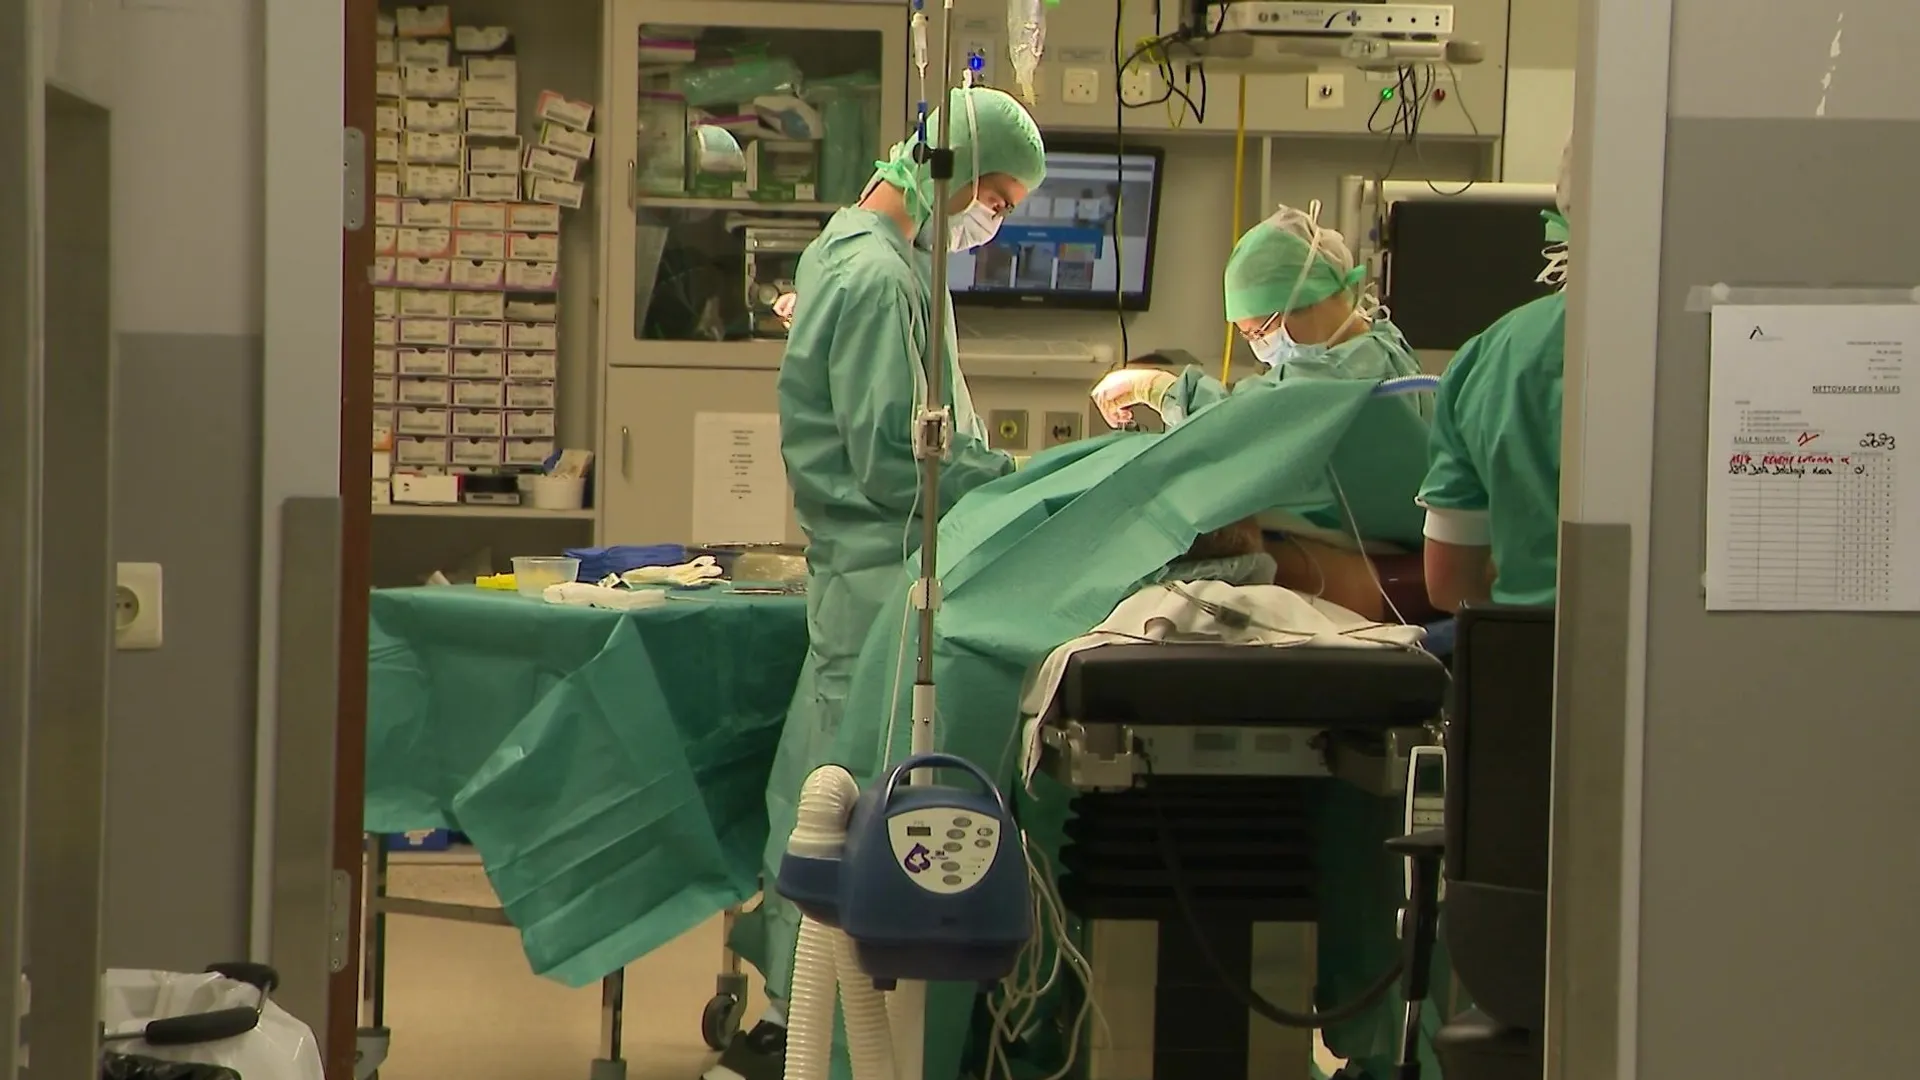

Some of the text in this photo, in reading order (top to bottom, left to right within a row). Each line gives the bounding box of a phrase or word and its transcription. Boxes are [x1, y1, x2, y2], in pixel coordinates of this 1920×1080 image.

[1812, 385, 1900, 394] NETTOYAGE DES SALLES
